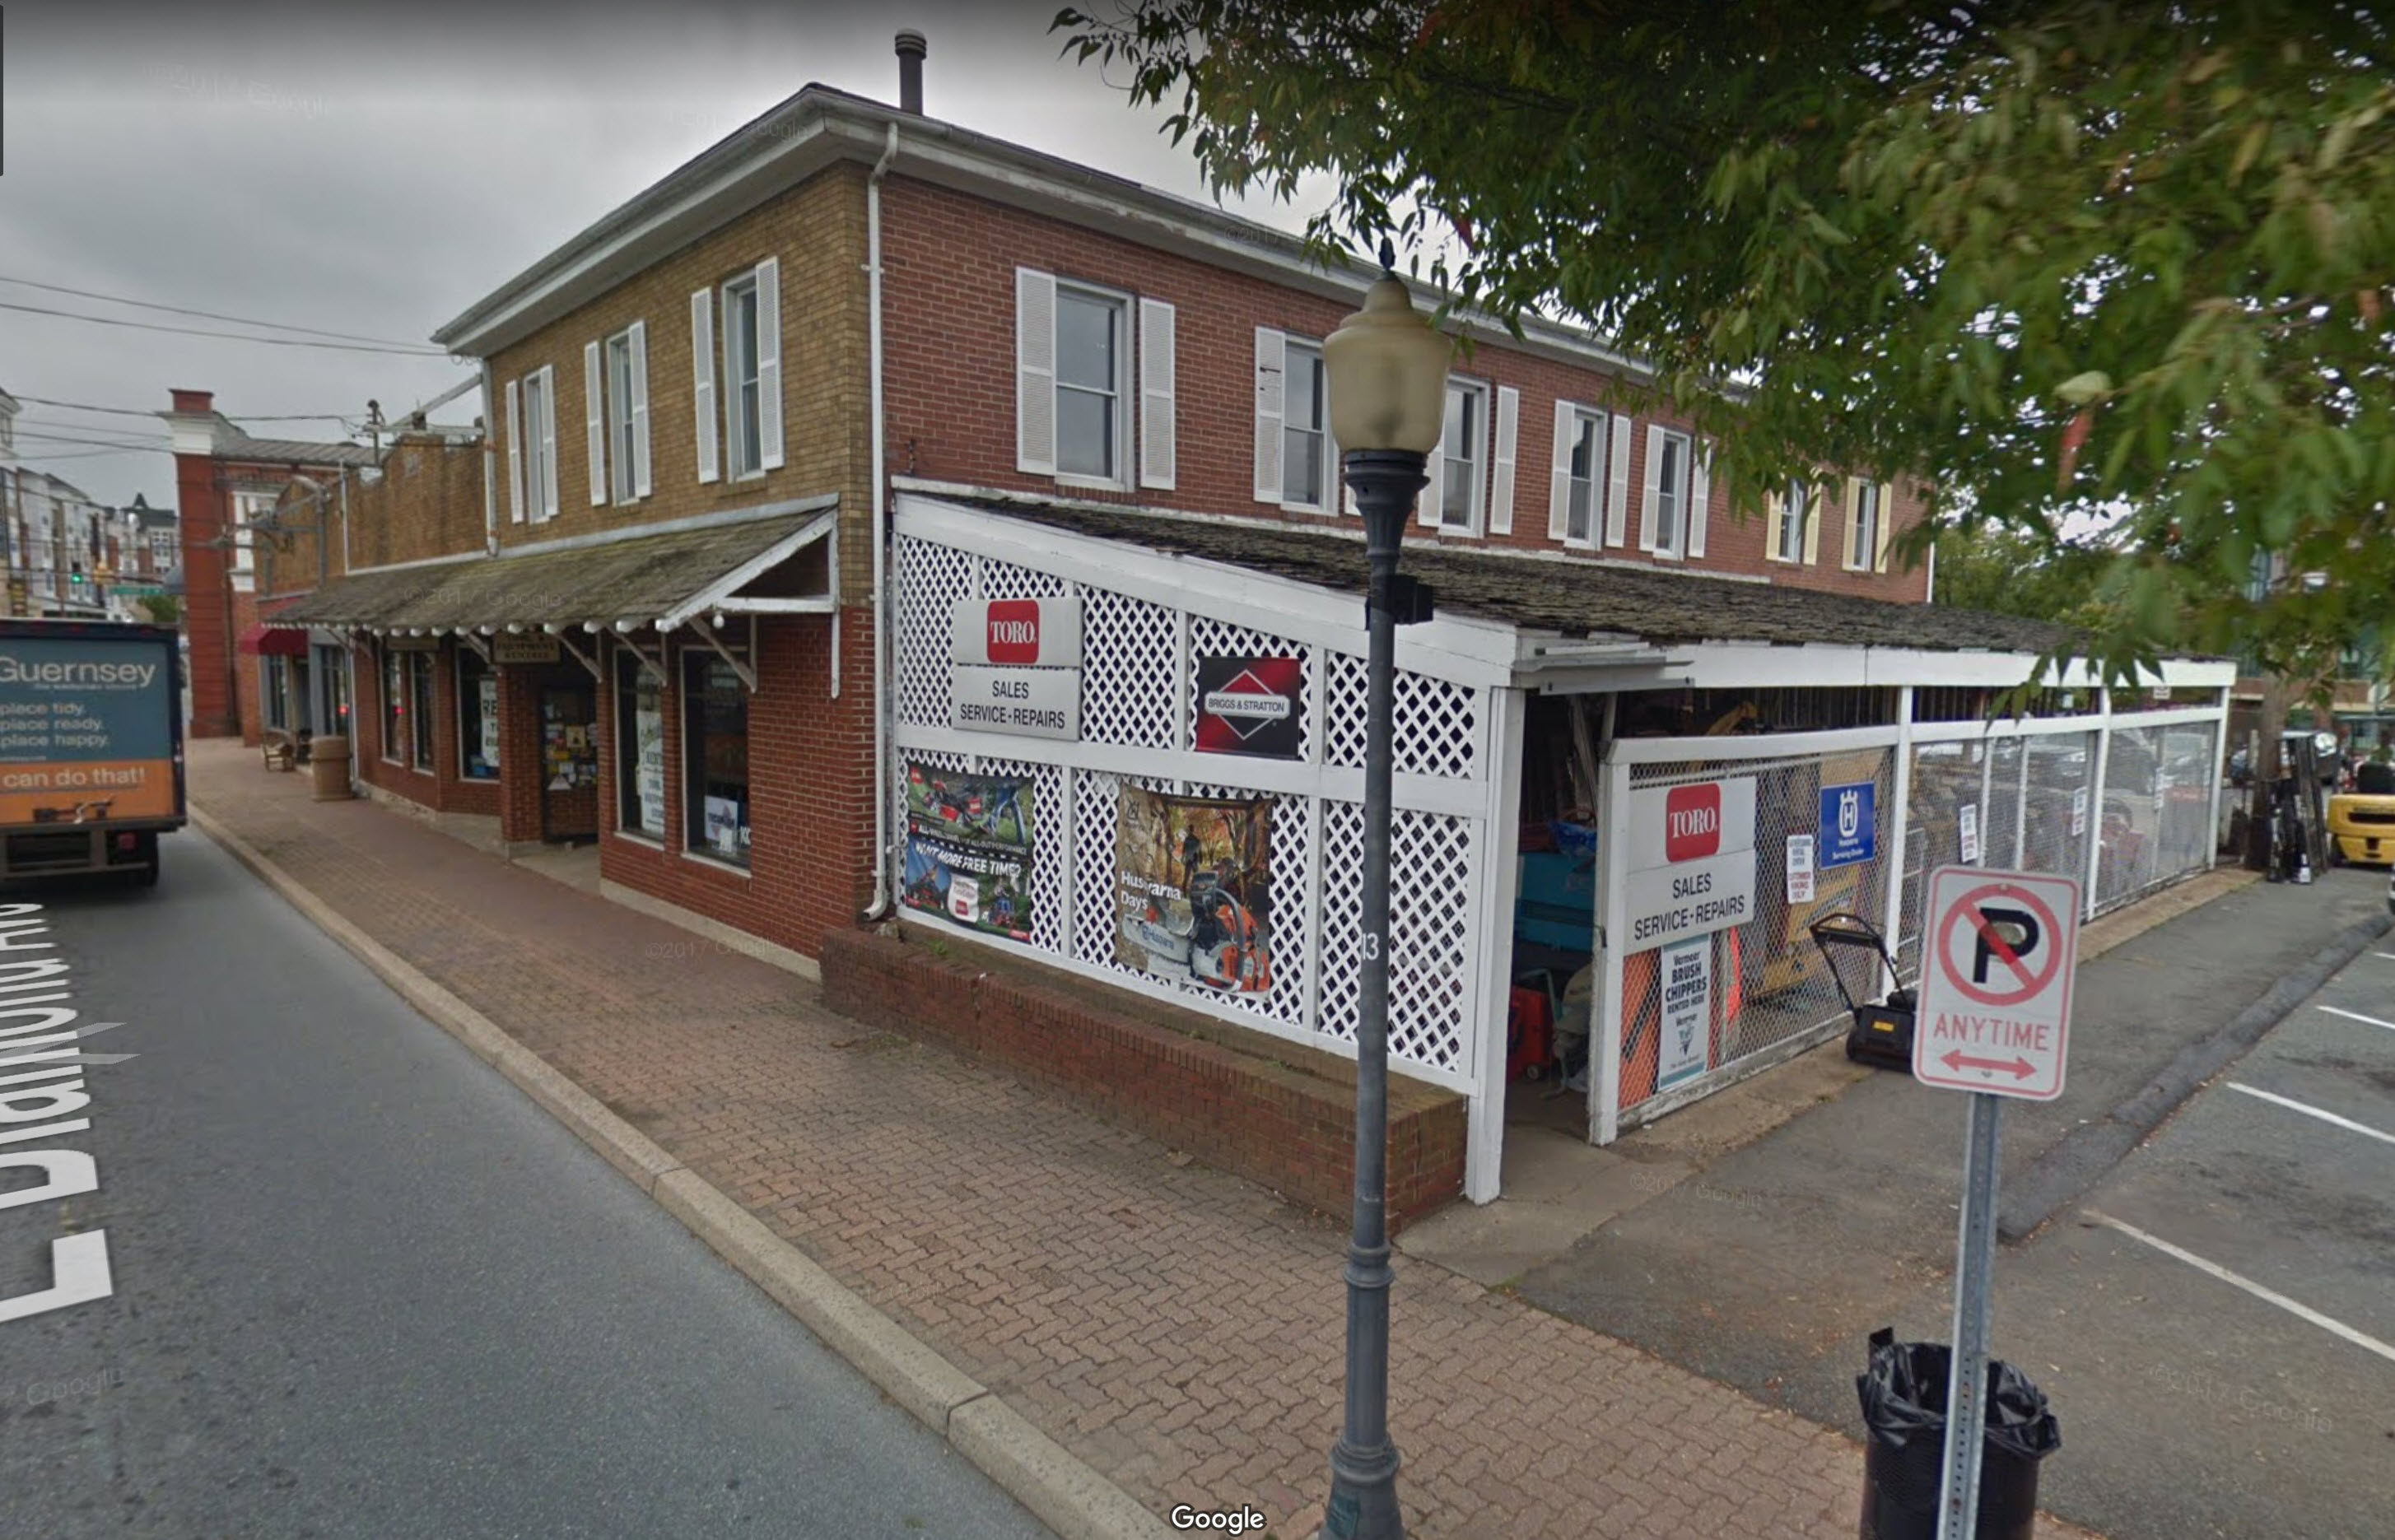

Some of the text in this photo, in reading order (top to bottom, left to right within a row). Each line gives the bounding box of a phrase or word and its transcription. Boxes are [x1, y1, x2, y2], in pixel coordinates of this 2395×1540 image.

[990, 621, 1036, 644] TORO
[0, 656, 156, 687] Guernsey
[992, 680, 1029, 700] SALES
[0, 702, 86, 716] place tidy.
[1208, 698, 1284, 712] BRIGGS & STRATTON
[0, 718, 105, 733] place ready.
[1, 733, 109, 749] place happy.
[2, 767, 145, 788] can do that!
[1670, 807, 1717, 839] TORO
[916, 840, 940, 856] WANT
[937, 849, 963, 868] MORE
[962, 855, 987, 874] FREE
[1121, 870, 1181, 901] Husvarna
[1672, 872, 1712, 899] SALES
[1121, 889, 1148, 914] Days
[1671, 961, 1702, 984] BRUSH
[1666, 975, 1707, 1003] CHIPPERS
[1933, 1012, 2051, 1052] ANYTIME
